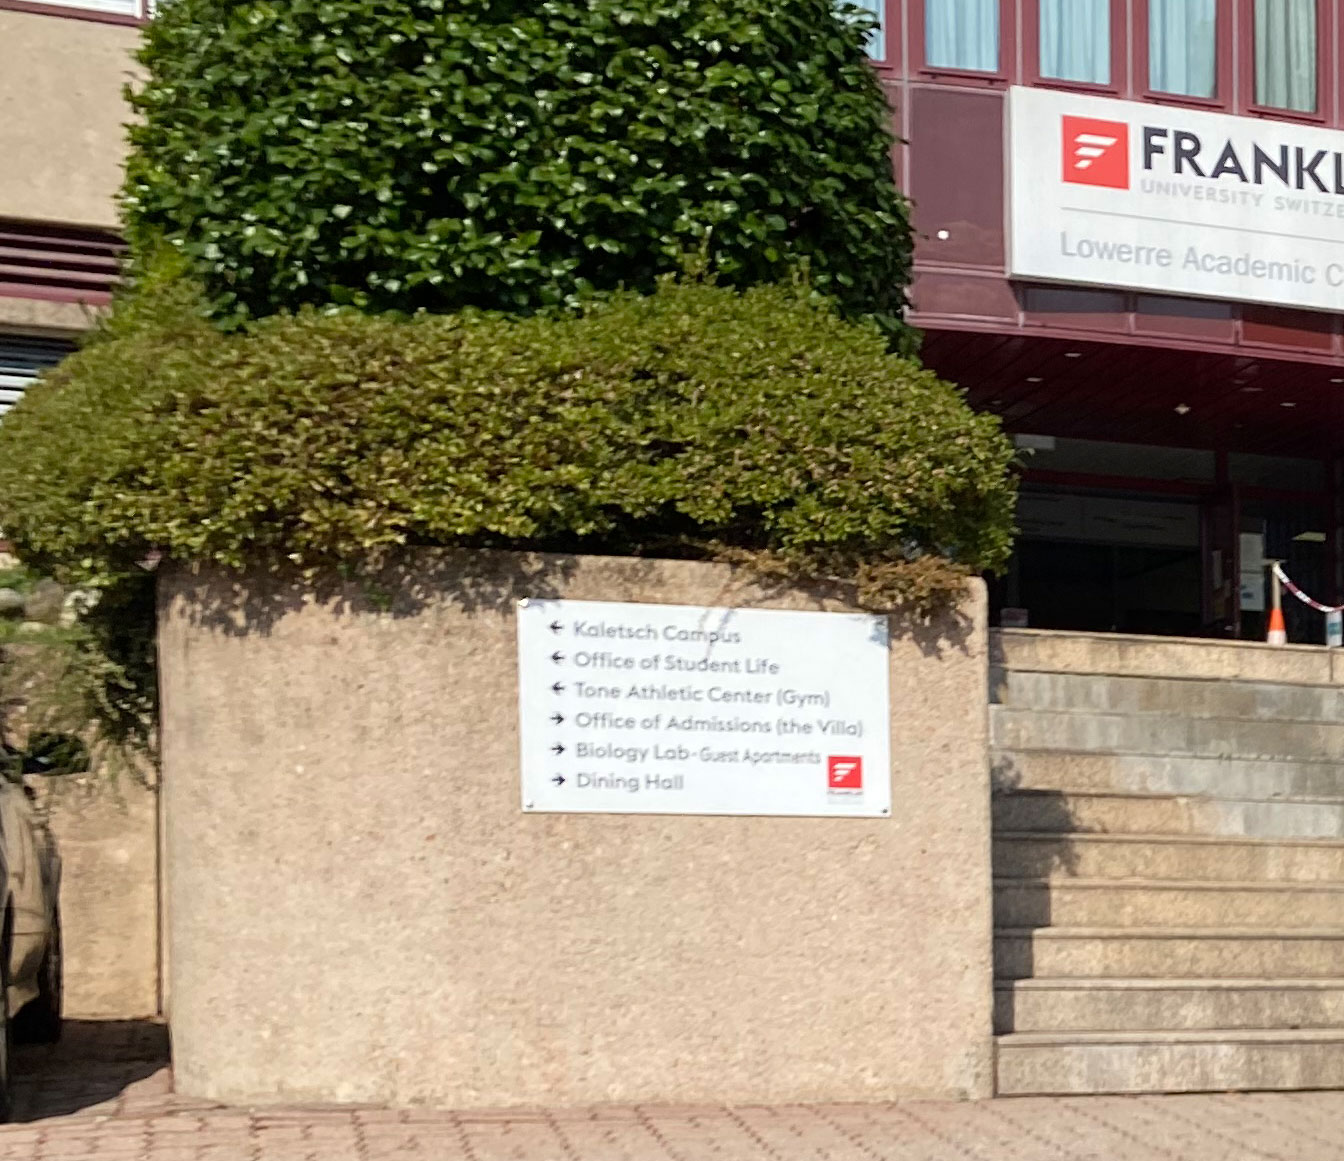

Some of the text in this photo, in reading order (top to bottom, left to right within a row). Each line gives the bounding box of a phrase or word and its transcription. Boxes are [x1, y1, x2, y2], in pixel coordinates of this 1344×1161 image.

[1140, 178, 1264, 207] UNIVERSITY
[1060, 231, 1173, 267] Lowerre
[1182, 247, 1316, 285] Academic
[574, 621, 741, 646] Kaletsch Campus
[574, 651, 780, 675] Office of Student Life
[574, 681, 830, 708] Tone Athletic Center (Gym)
[575, 712, 863, 738] Office of Admissions (the Villa)
[576, 742, 649, 763] Biology
[743, 749, 821, 766] Apartments
[577, 772, 684, 792] Dining Hall
